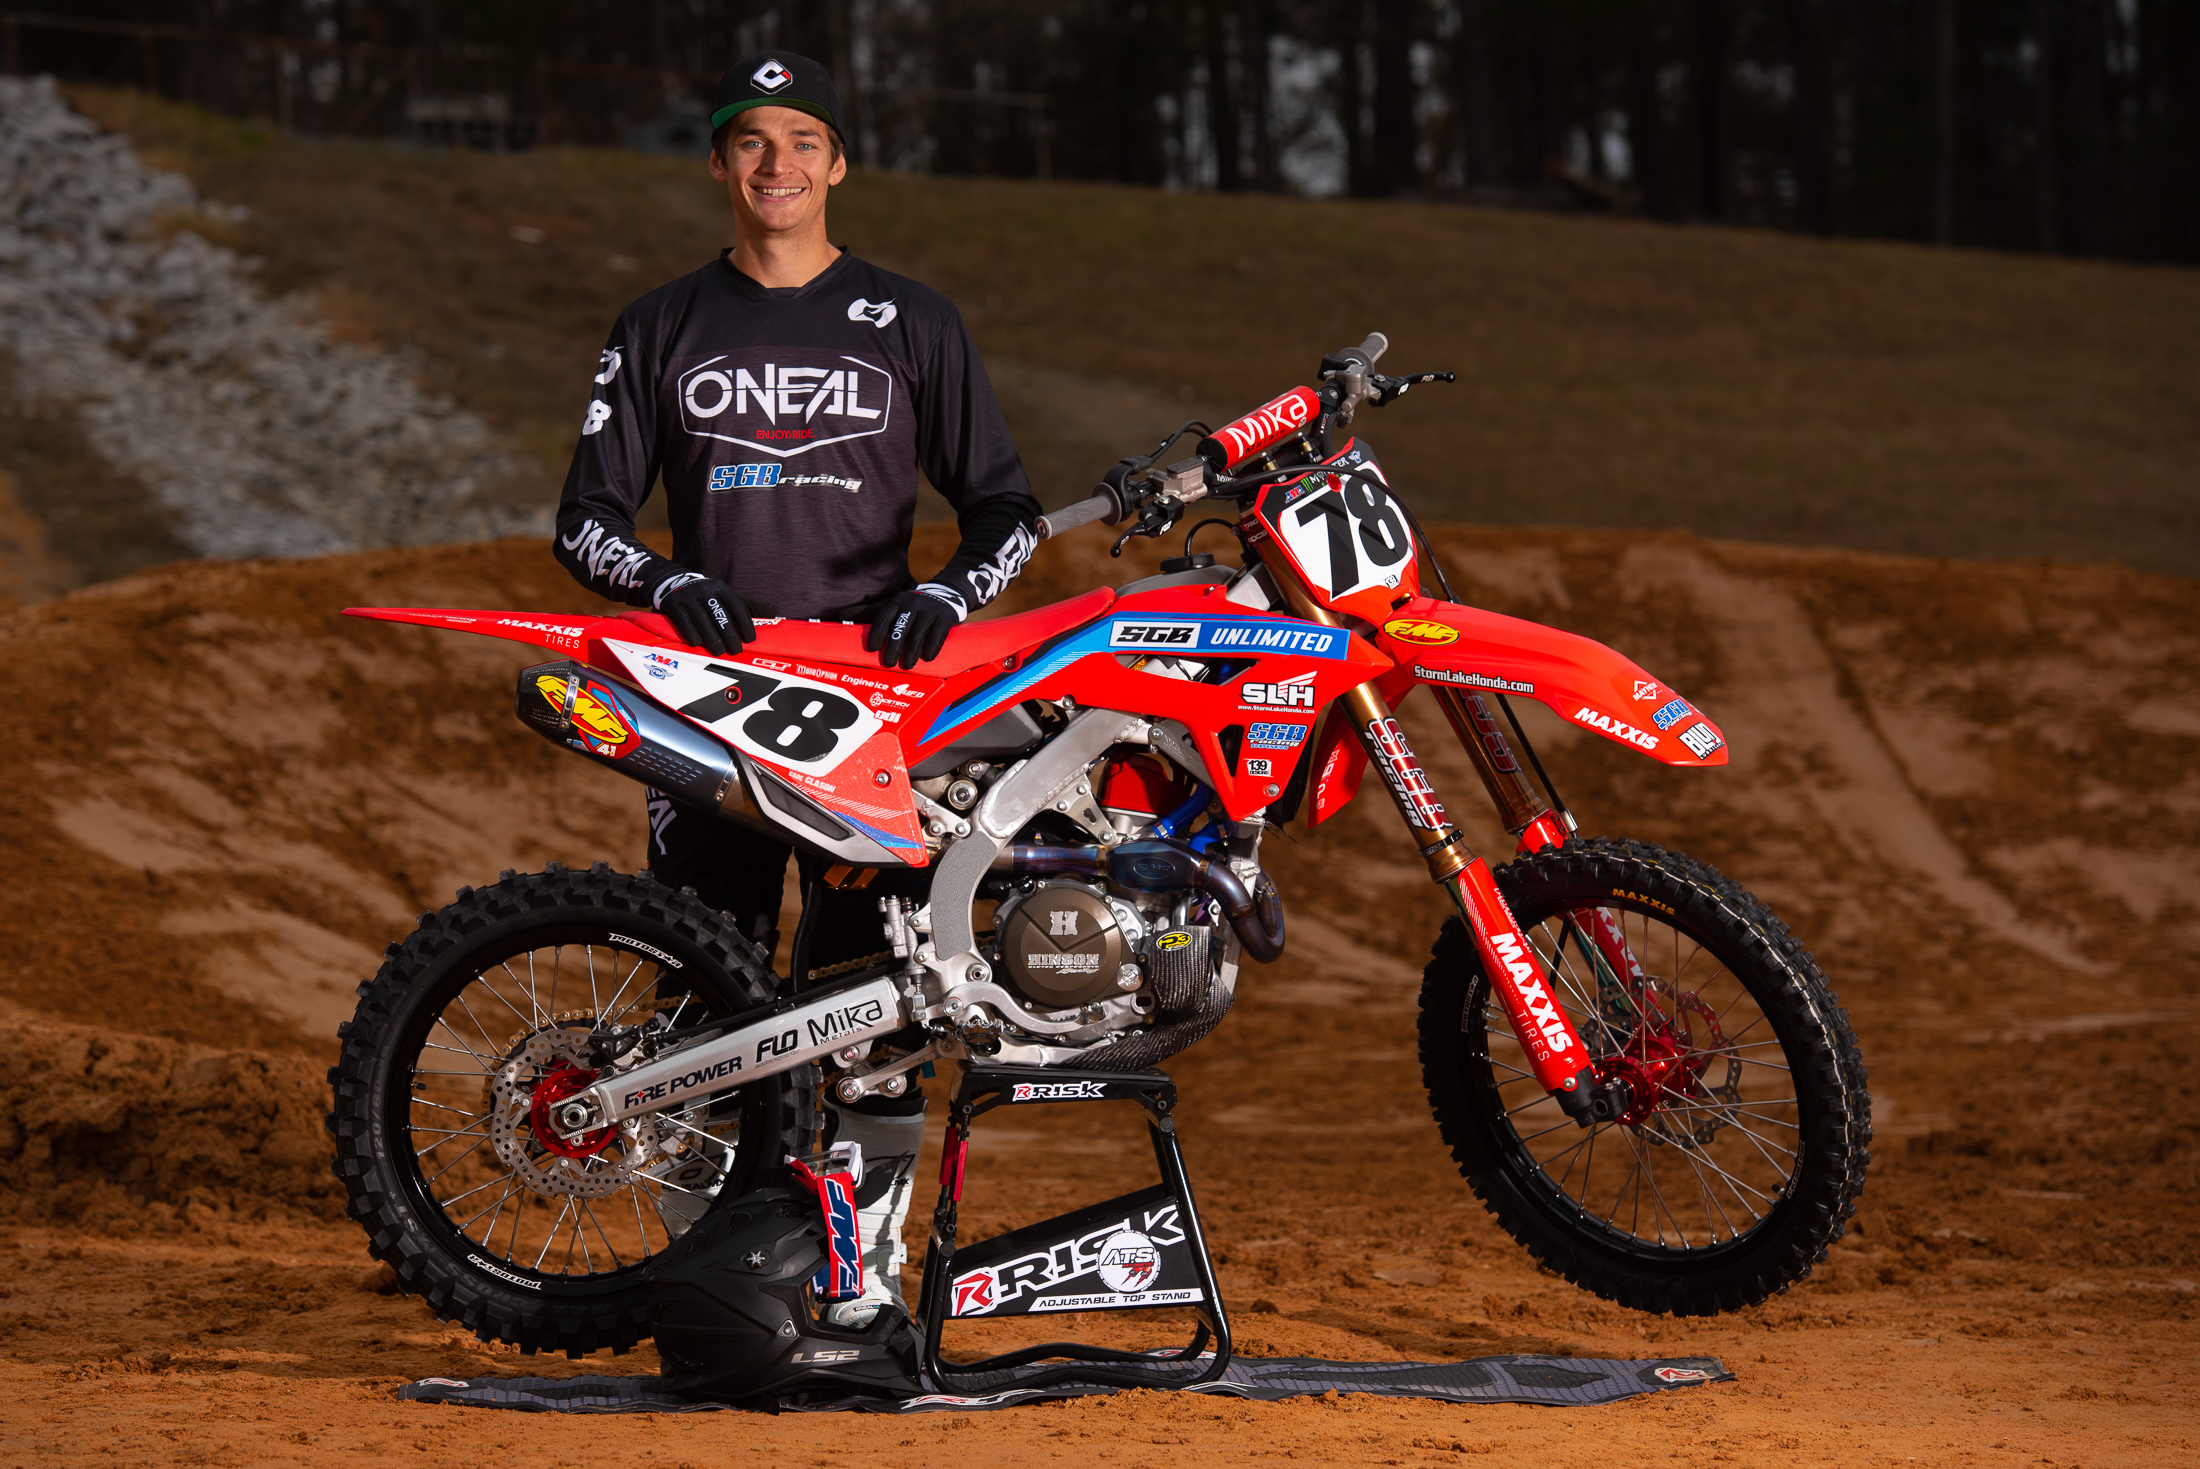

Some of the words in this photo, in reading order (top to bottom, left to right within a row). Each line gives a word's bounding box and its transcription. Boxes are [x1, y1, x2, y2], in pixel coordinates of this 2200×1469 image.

[756, 430, 789, 440] ENJOY
[1226, 394, 1307, 457] Mika
[1295, 468, 1409, 598] 78
[496, 618, 585, 637] MAXXIS
[1116, 626, 1195, 643] SGB
[1210, 627, 1333, 652] UNLIMITED
[1385, 622, 1459, 640] FMF
[545, 633, 580, 649] TIRES
[643, 653, 679, 669] AMA
[1414, 665, 1534, 693] StormLakeHonda.com
[1239, 682, 1315, 708] SLH
[676, 663, 860, 762] 78
[1238, 705, 1315, 714] www.StormLakeHonda.com
[1247, 722, 1308, 742] SGB
[1574, 707, 1659, 750] MAXXIS
[1248, 760, 1268, 770] 139
[1369, 718, 1454, 829] SGB
[804, 776, 836, 793] CLASON
[1612, 888, 1676, 915] MAXXIS
[1028, 953, 1099, 966] HINSON
[1490, 931, 1574, 1053] MAXXIS
[807, 999, 884, 1046] Mika
[820, 1025, 862, 1045] Metals
[1517, 1008, 1550, 1062] TIRES
[756, 1029, 799, 1063] FLO
[670, 1055, 743, 1094] POWER
[1038, 1297, 1116, 1308] ADJUSTABLE
[1123, 1294, 1146, 1303] TOP
[1152, 1291, 1191, 1301] STAND
[791, 1350, 860, 1364] LS2
